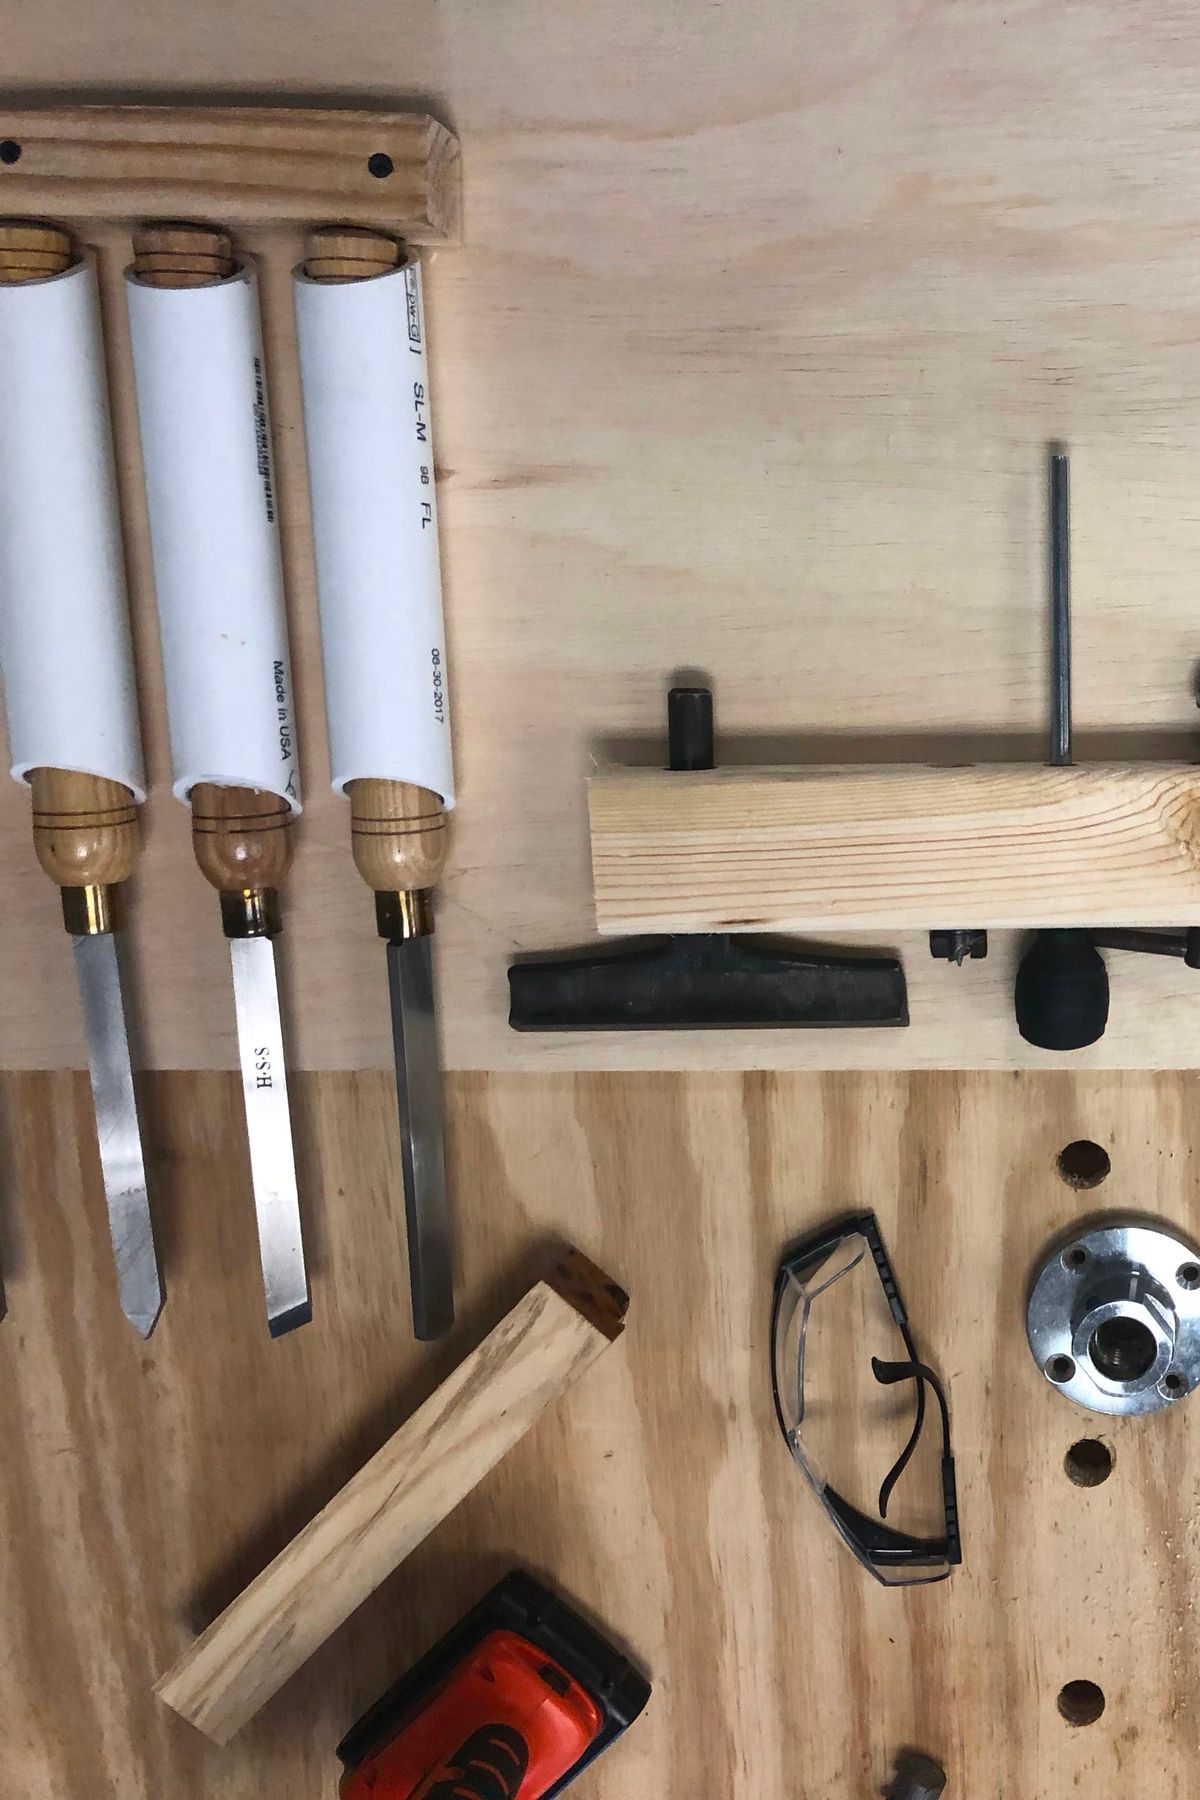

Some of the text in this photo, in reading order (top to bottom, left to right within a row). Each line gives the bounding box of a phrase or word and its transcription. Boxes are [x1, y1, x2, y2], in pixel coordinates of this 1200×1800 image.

[413, 382, 427, 442] SL-M
[420, 501, 432, 529] FL
[431, 648, 444, 723] 08-30-2017
[273, 660, 292, 761] Made in USA
